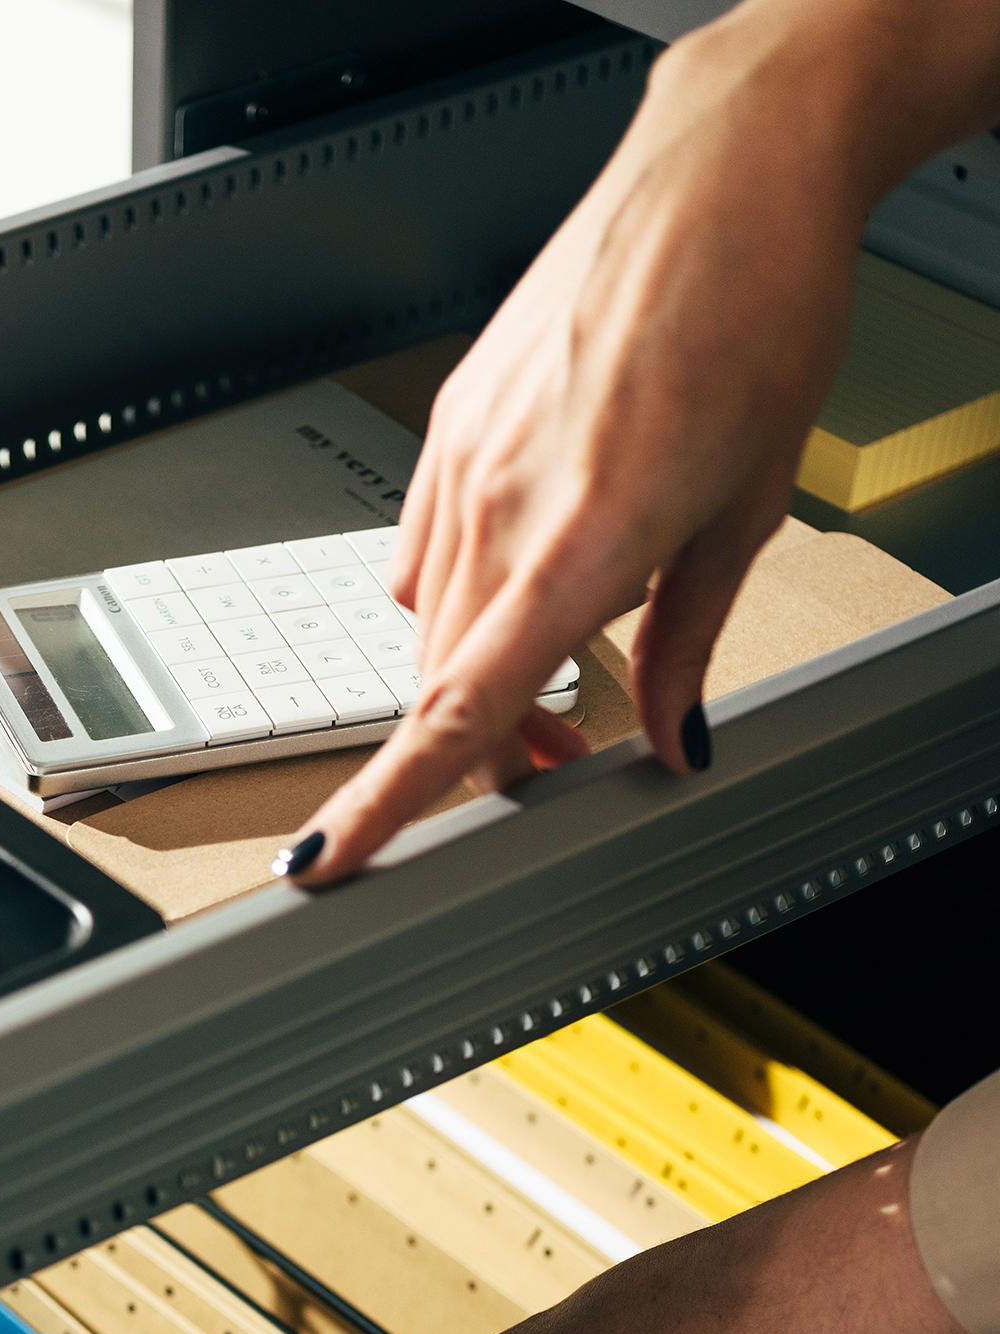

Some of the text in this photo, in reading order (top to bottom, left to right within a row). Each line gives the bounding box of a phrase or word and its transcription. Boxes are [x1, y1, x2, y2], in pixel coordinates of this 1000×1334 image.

[296, 425, 333, 448] my
[336, 451, 390, 485] very
[96, 585, 122, 614] Canon
[153, 598, 178, 625] MARGIN
[361, 611, 379, 620] 5
[301, 621, 319, 630] 8
[178, 636, 197, 653] SELL
[256, 662, 272, 676] RM
[272, 659, 288, 674] CM
[198, 667, 221, 689] COST
[214, 705, 232, 721] ON
[232, 703, 248, 718] CA
